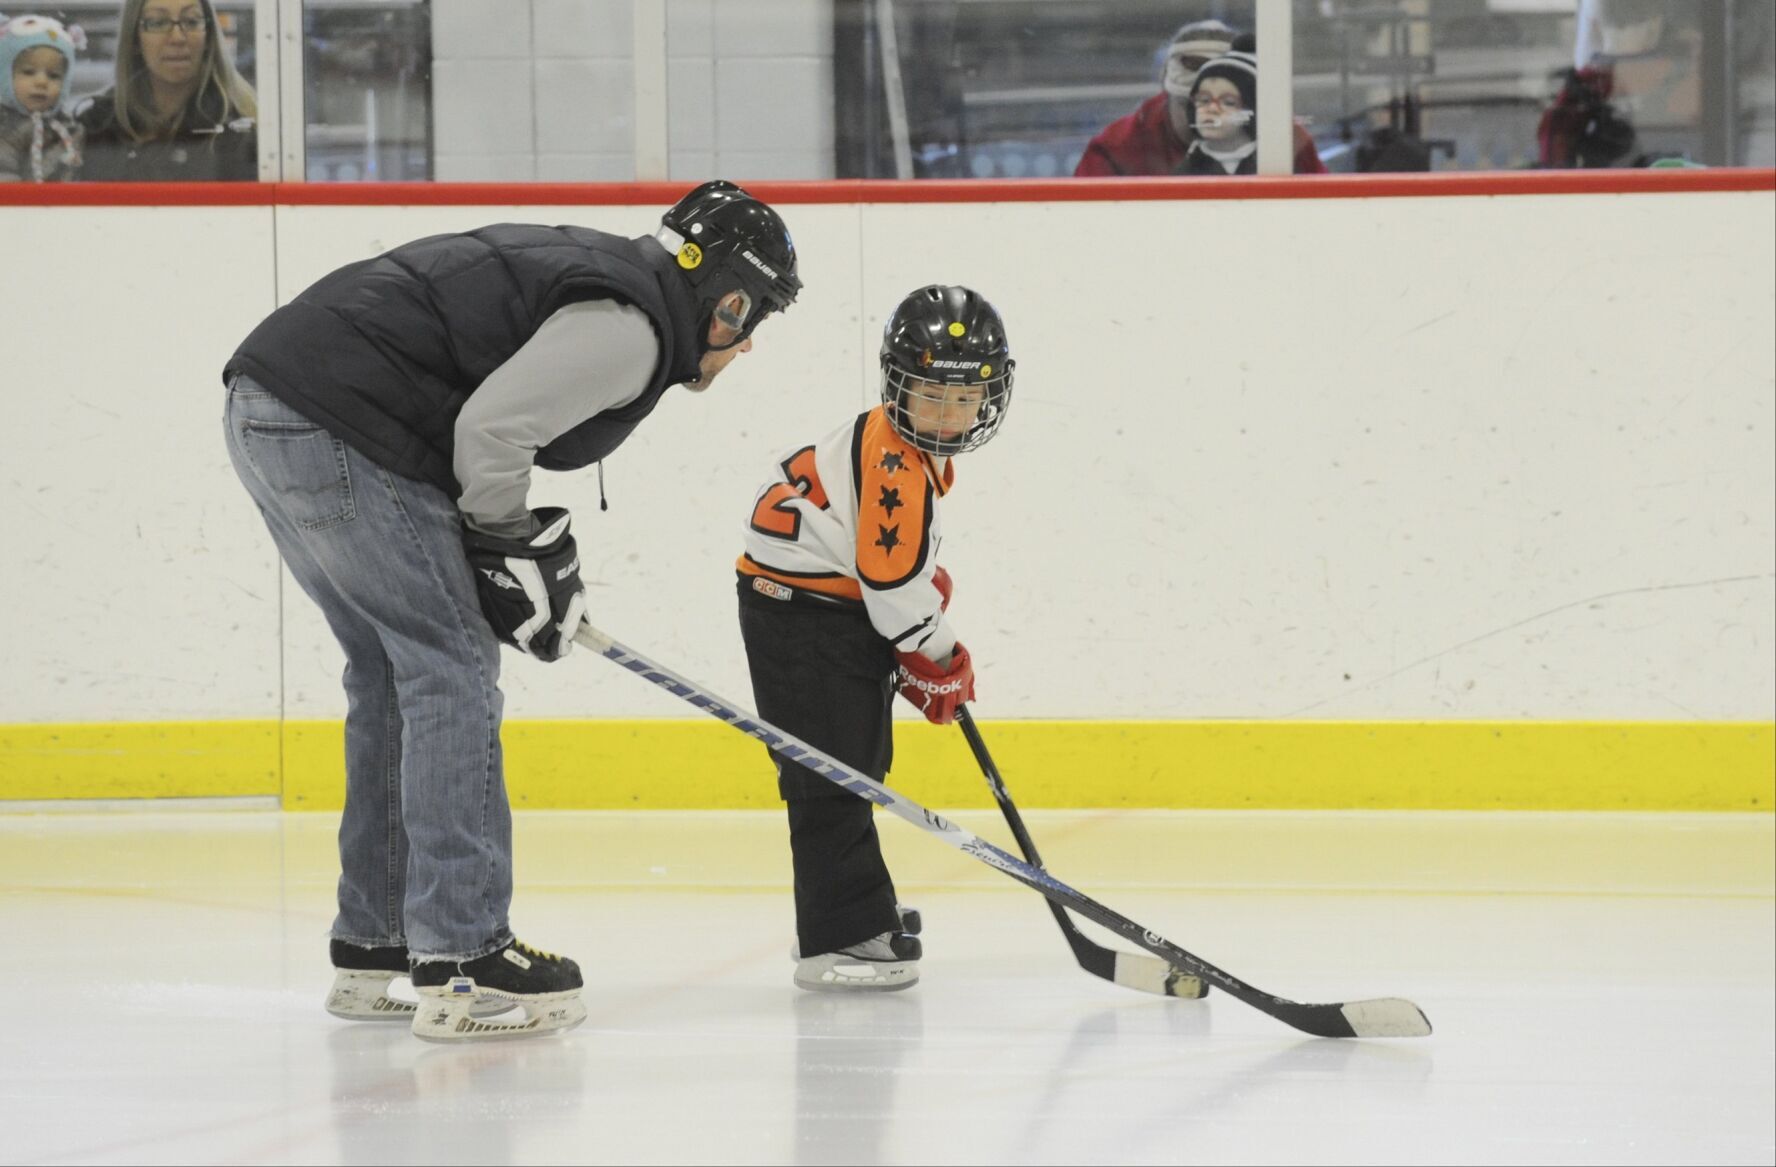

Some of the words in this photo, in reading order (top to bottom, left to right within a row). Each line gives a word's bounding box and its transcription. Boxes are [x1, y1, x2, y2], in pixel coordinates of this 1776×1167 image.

[742, 250, 778, 280] BAUER
[932, 360, 981, 370] BAUER
[753, 577, 792, 600] CCM
[899, 664, 963, 694] Reebok
